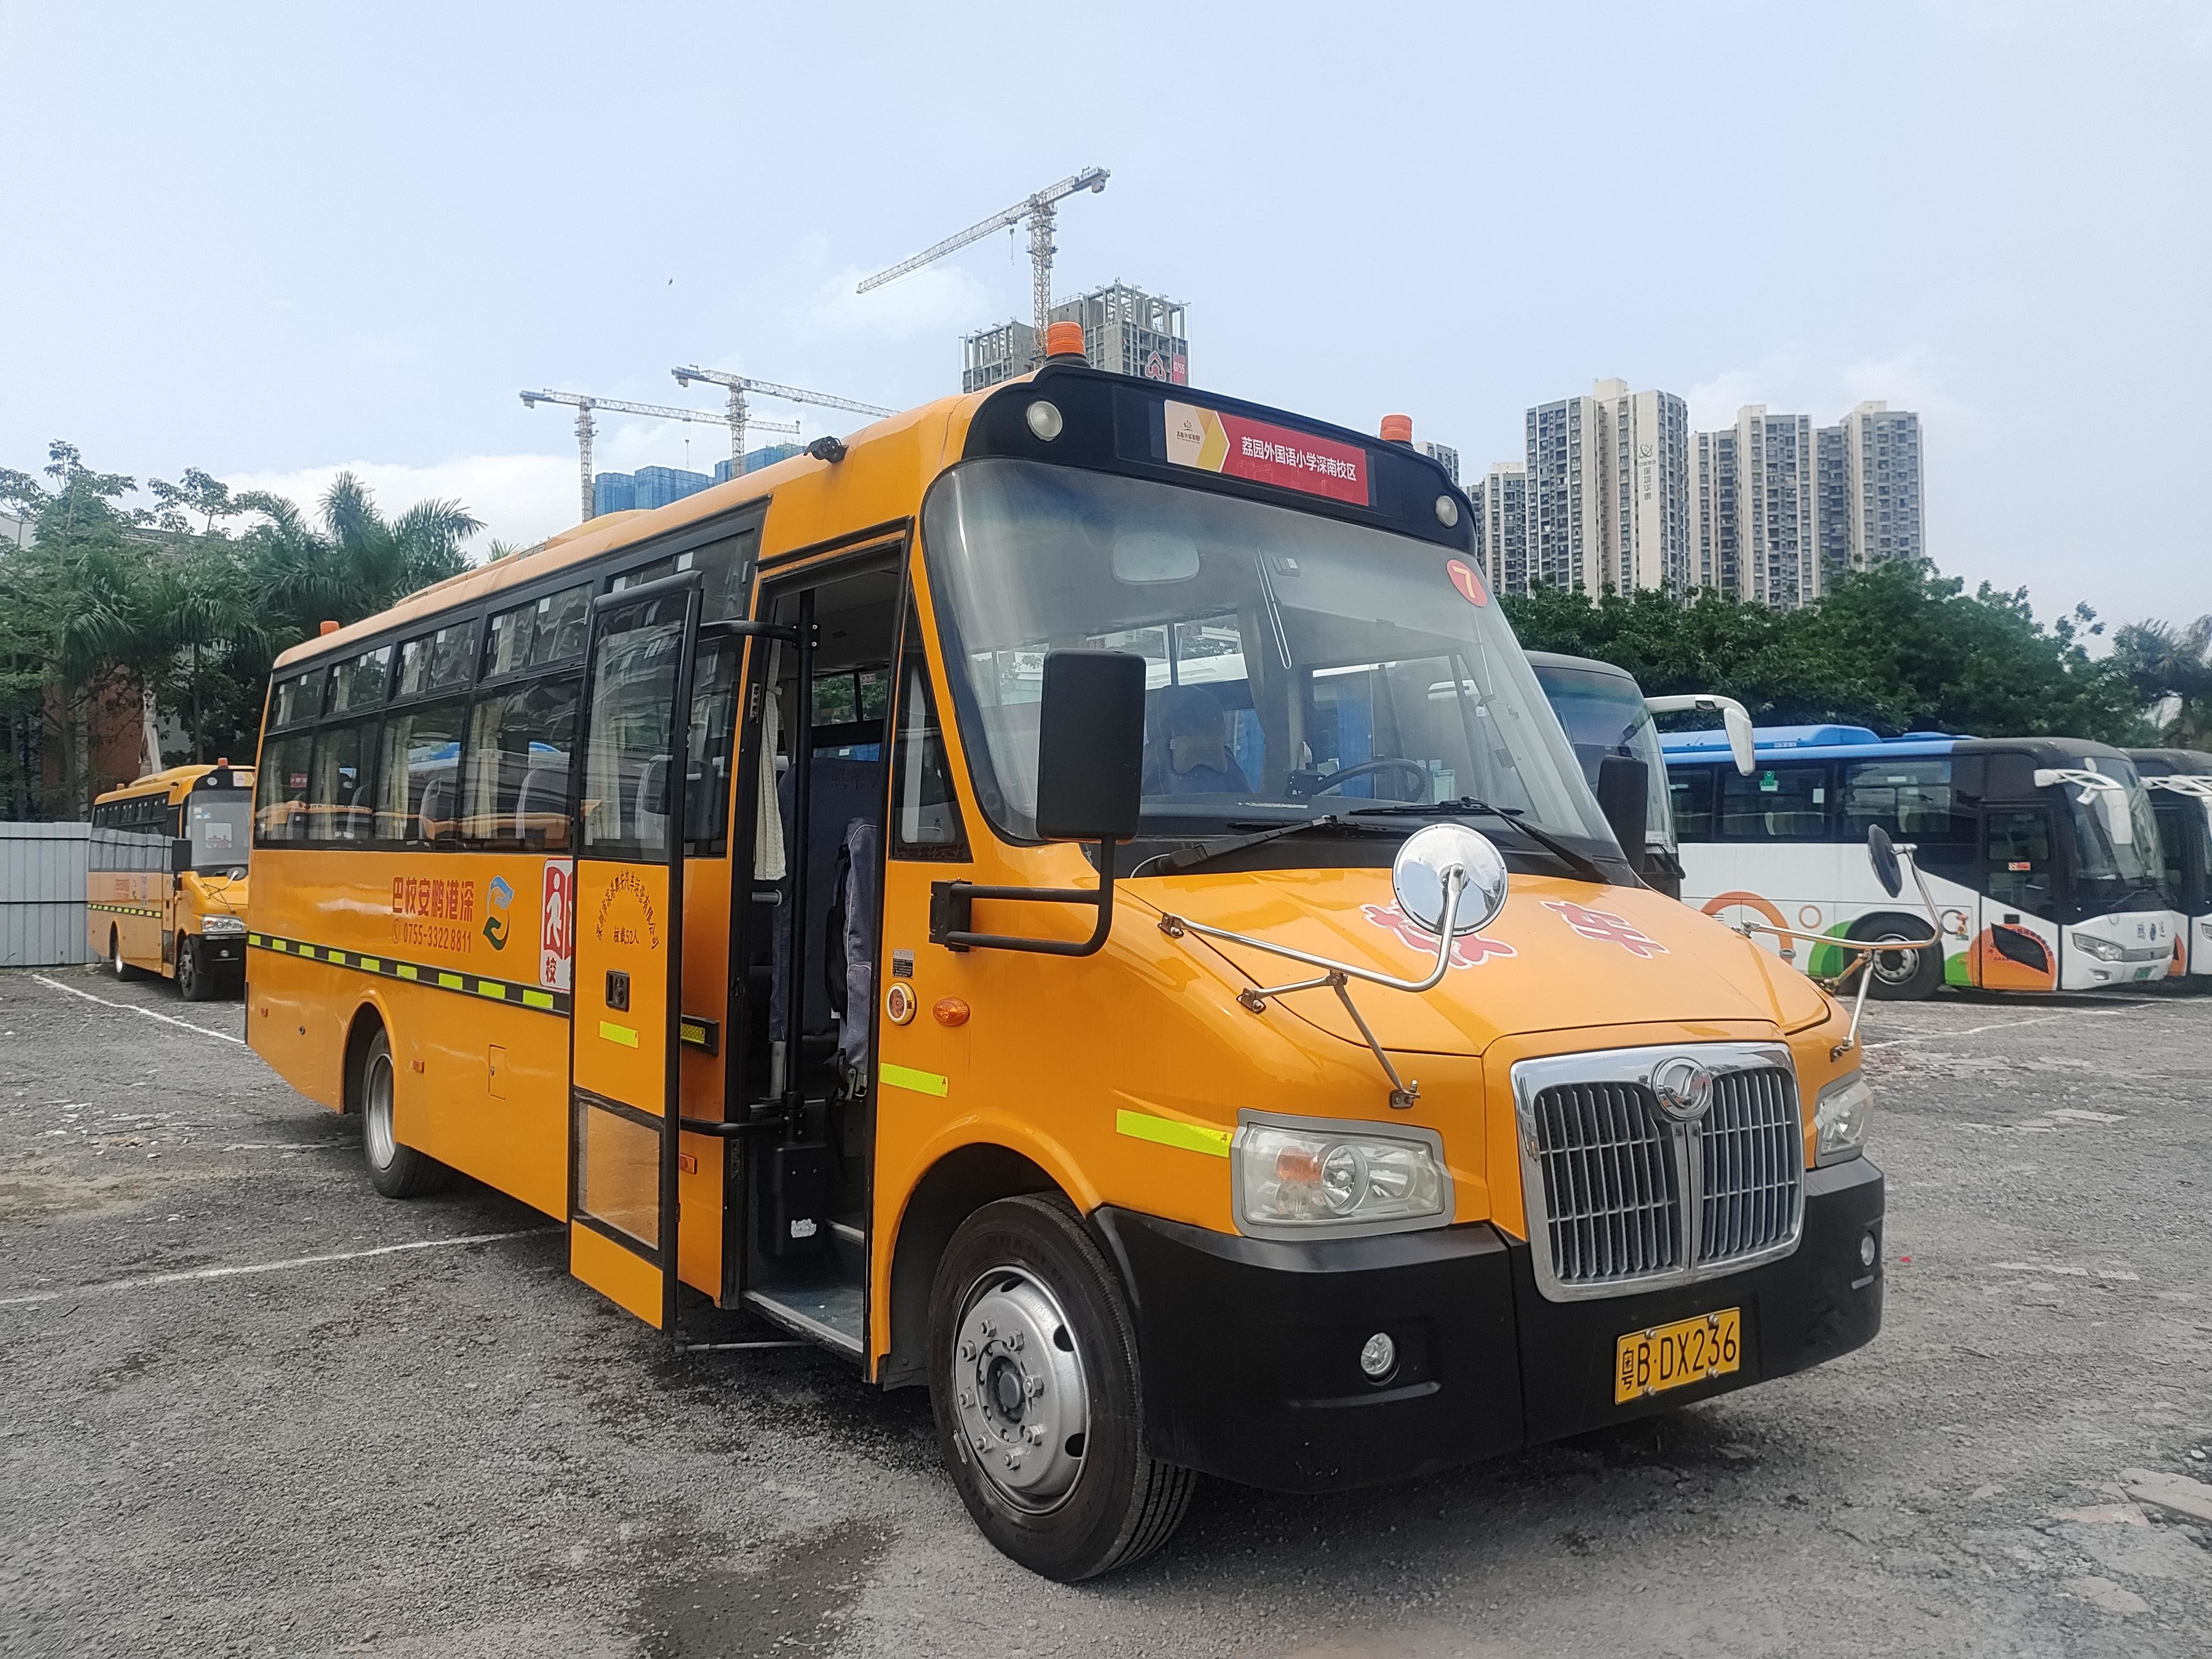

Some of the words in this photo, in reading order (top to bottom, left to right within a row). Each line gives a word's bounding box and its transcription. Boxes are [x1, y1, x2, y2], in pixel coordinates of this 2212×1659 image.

[1174, 361, 1185, 374] 0755
[1242, 436, 1357, 481] 荔园外国语小学深南校区
[1452, 565, 1476, 598] 7
[403, 922, 471, 954] 0755-33228811
[613, 927, 639, 945] 核载52人
